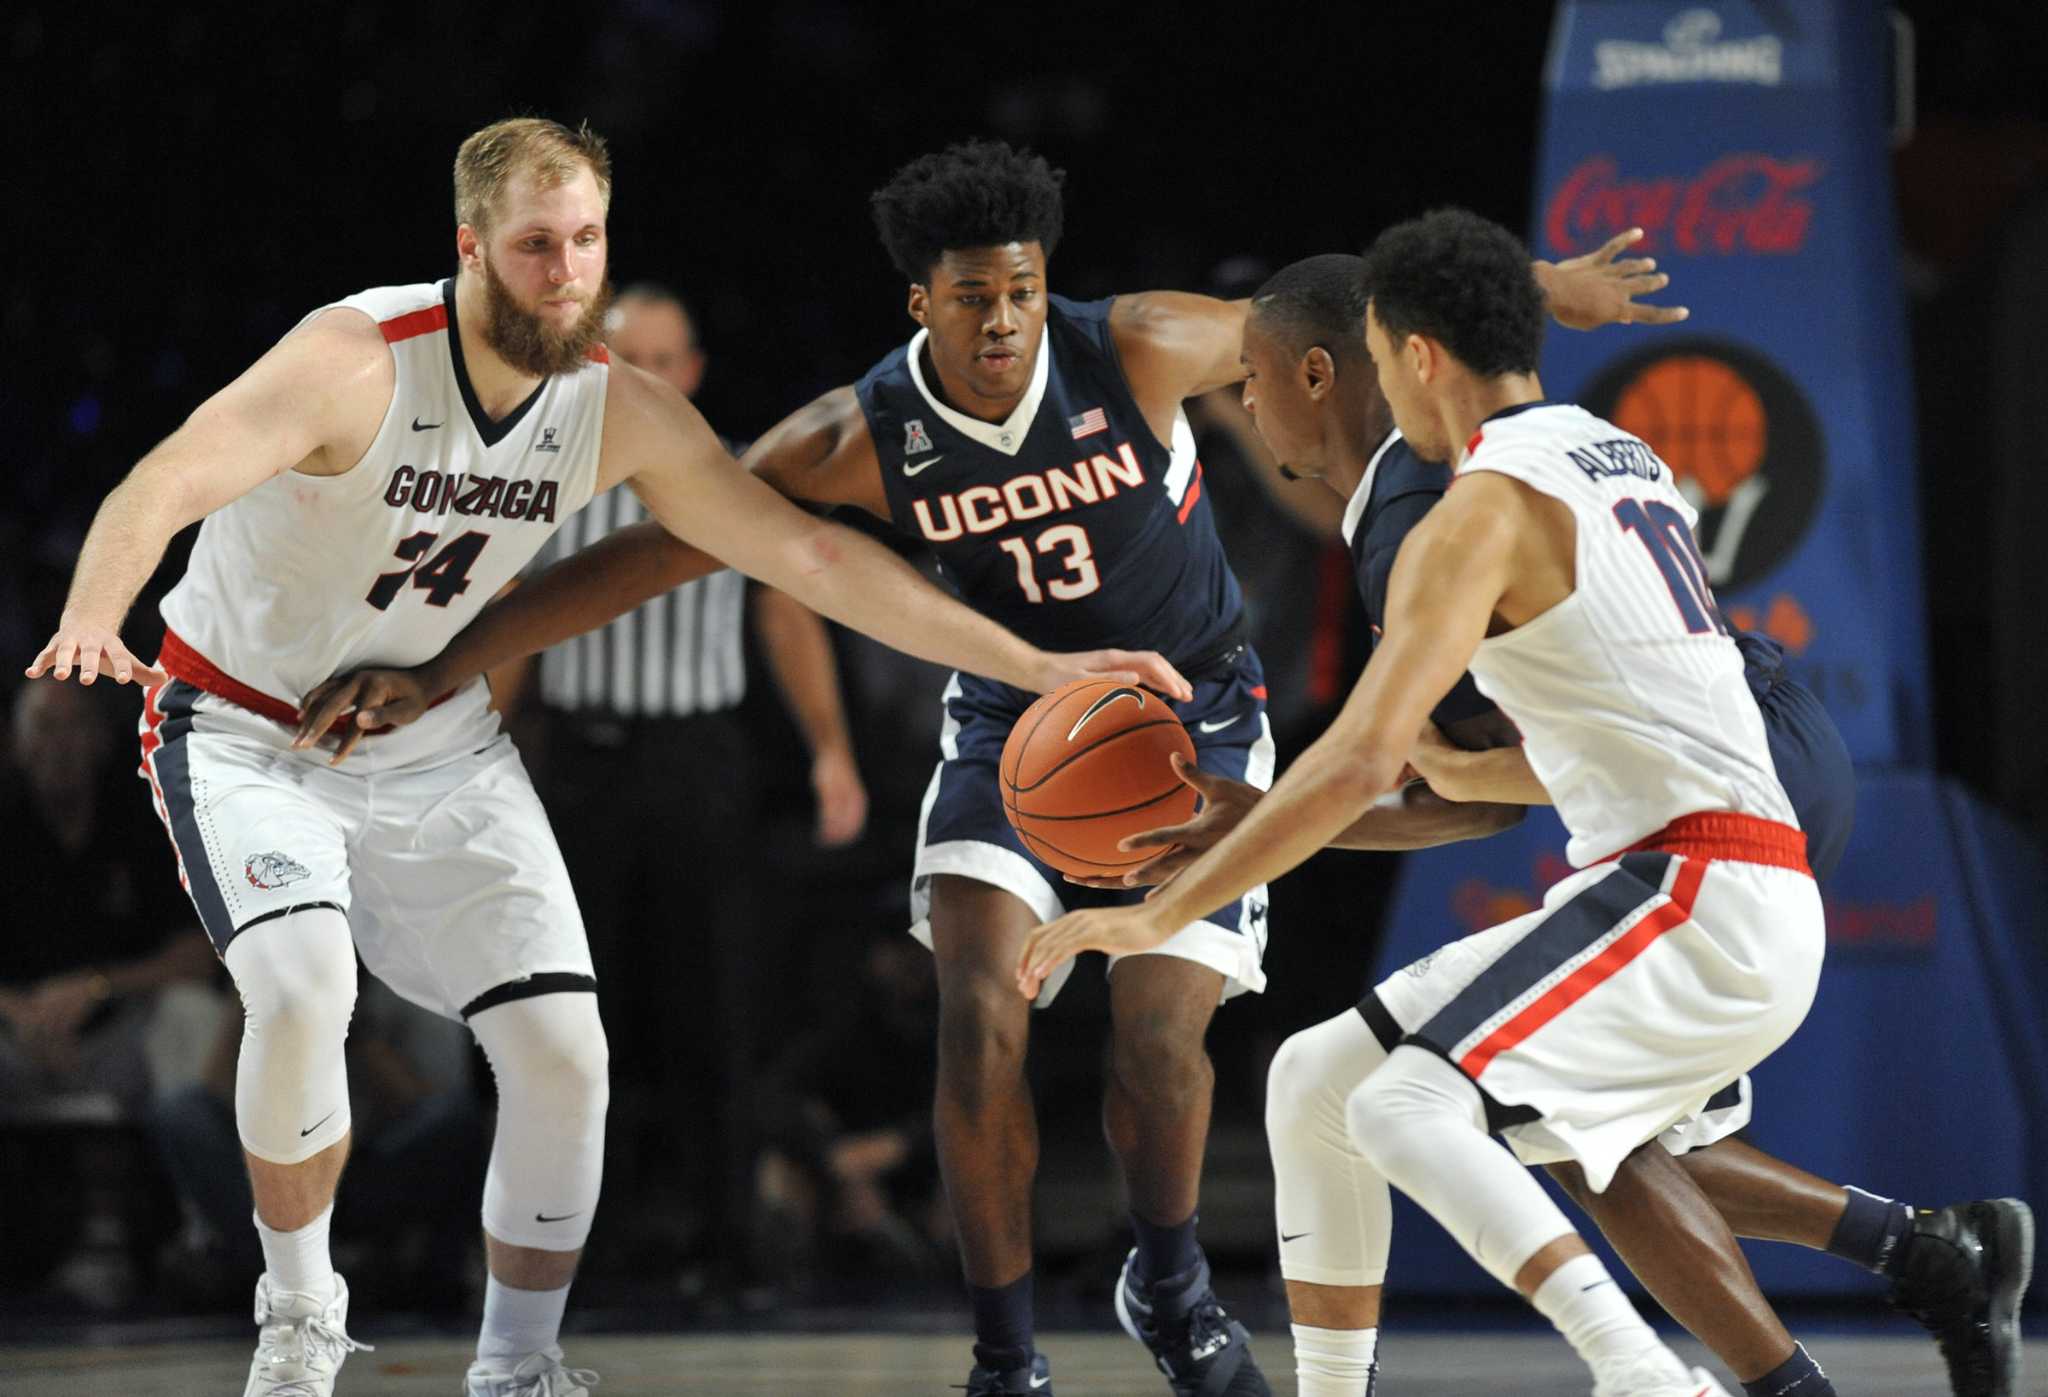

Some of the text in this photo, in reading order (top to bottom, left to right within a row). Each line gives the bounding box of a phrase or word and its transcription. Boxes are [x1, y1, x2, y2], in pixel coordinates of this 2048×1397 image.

[383, 465, 559, 523] GONZAGA
[913, 443, 1145, 542] UCONN
[365, 530, 491, 611] 24
[1000, 524, 1101, 604] 13
[1612, 497, 1728, 636] 10
